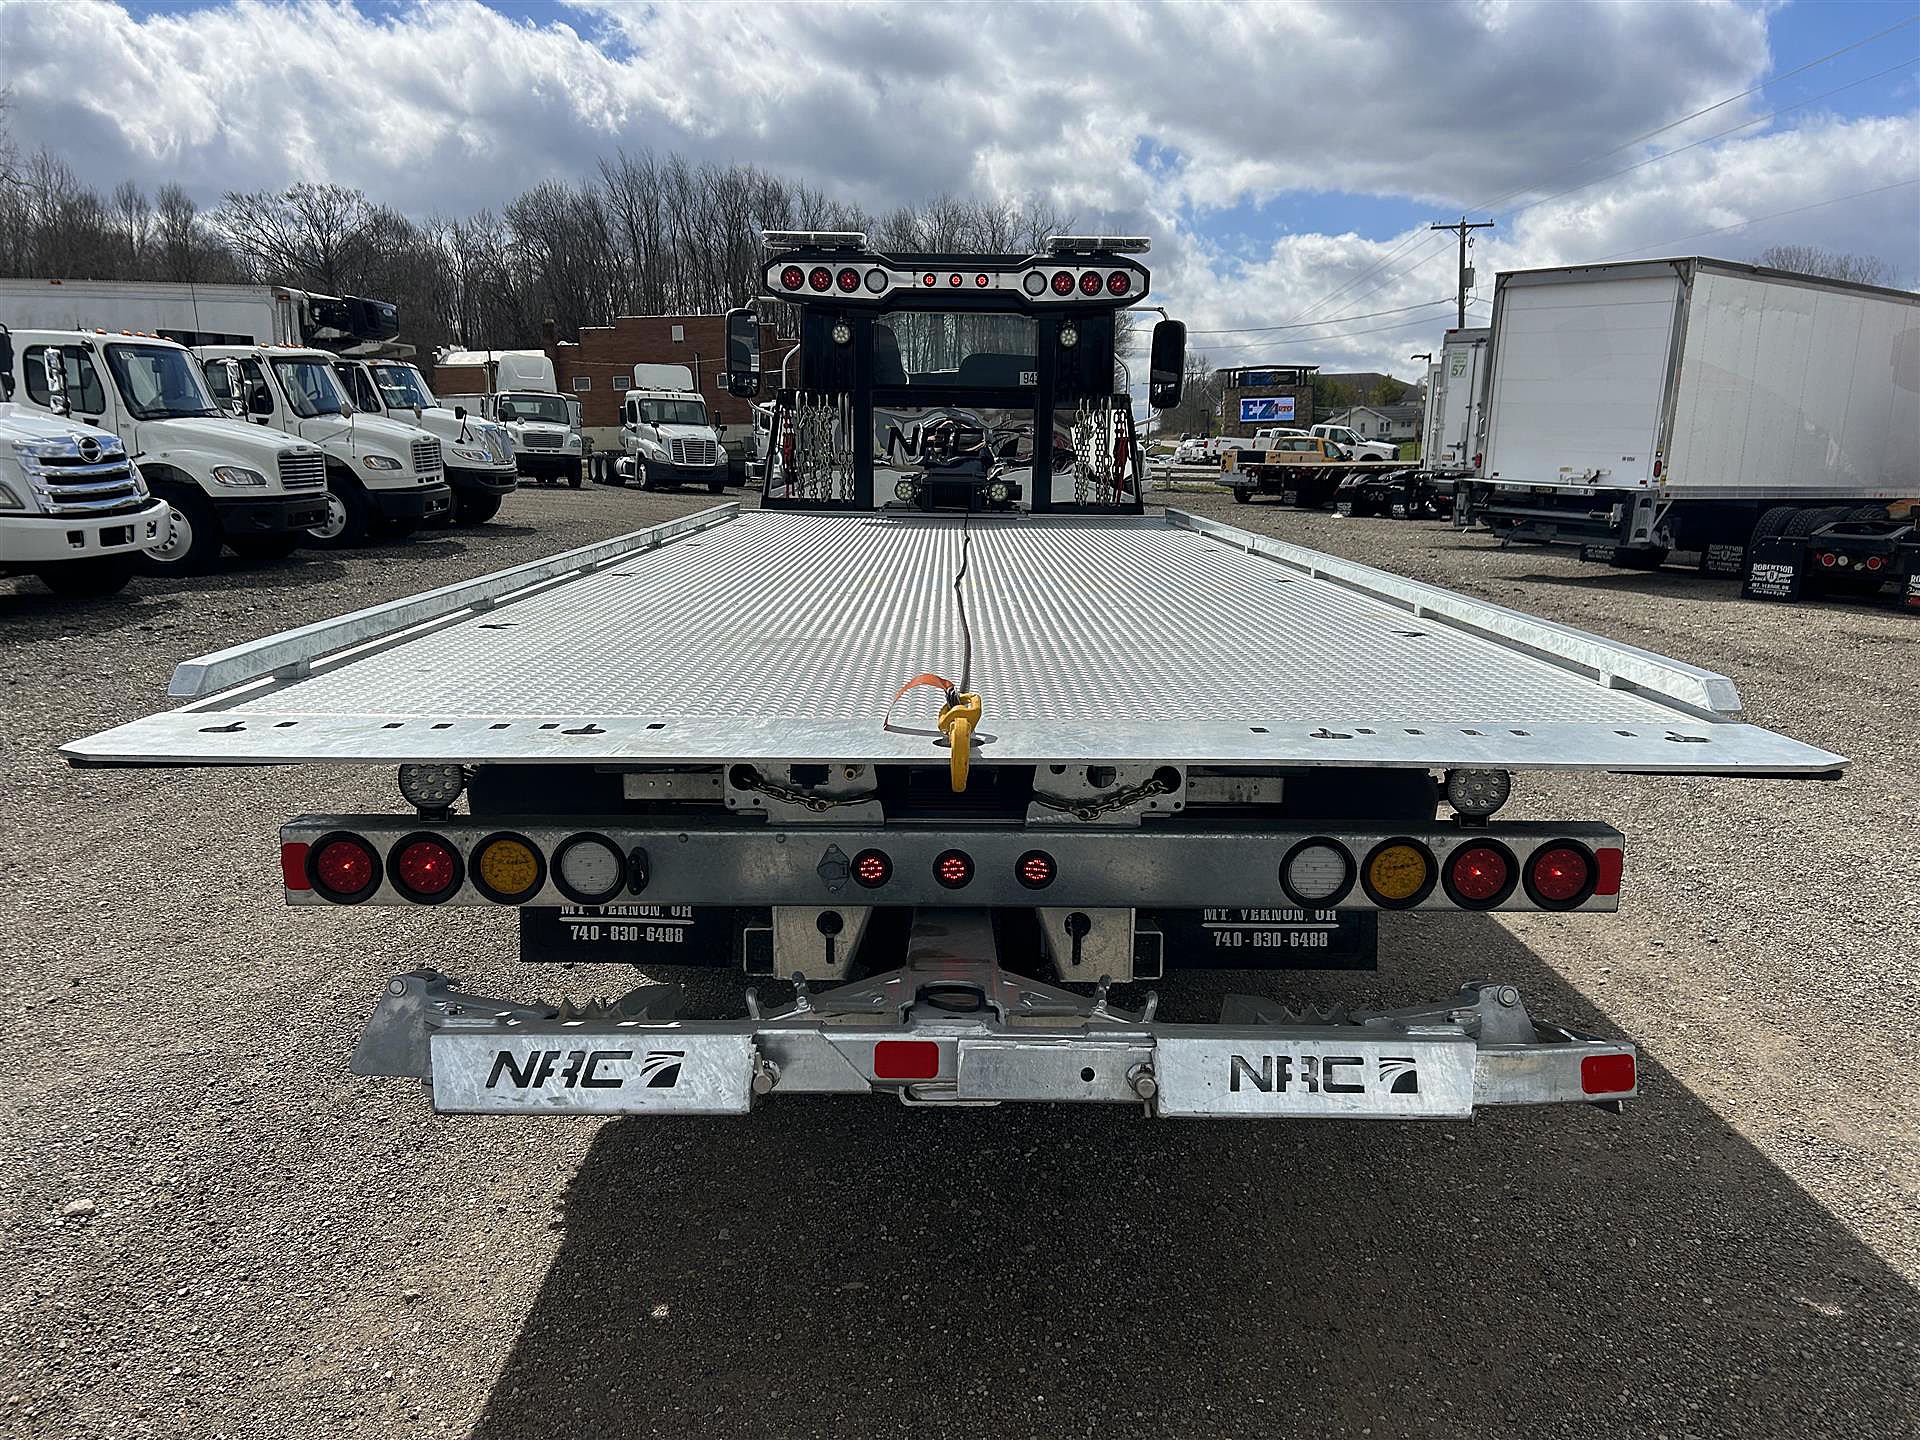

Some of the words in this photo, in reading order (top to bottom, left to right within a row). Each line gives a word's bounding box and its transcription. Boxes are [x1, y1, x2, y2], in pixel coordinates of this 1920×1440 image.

[1241, 400, 1276, 419] EZ
[1752, 563, 1793, 573] ROBERTSON
[599, 905, 665, 917] VERNON,
[1203, 908, 1232, 921] MT.
[1240, 909, 1308, 922] VERNON,
[570, 925, 684, 943] 740-830-6488
[1213, 931, 1328, 947] 740-830-6488
[485, 1050, 633, 1089] NRC
[1229, 1055, 1365, 1093] NRC
